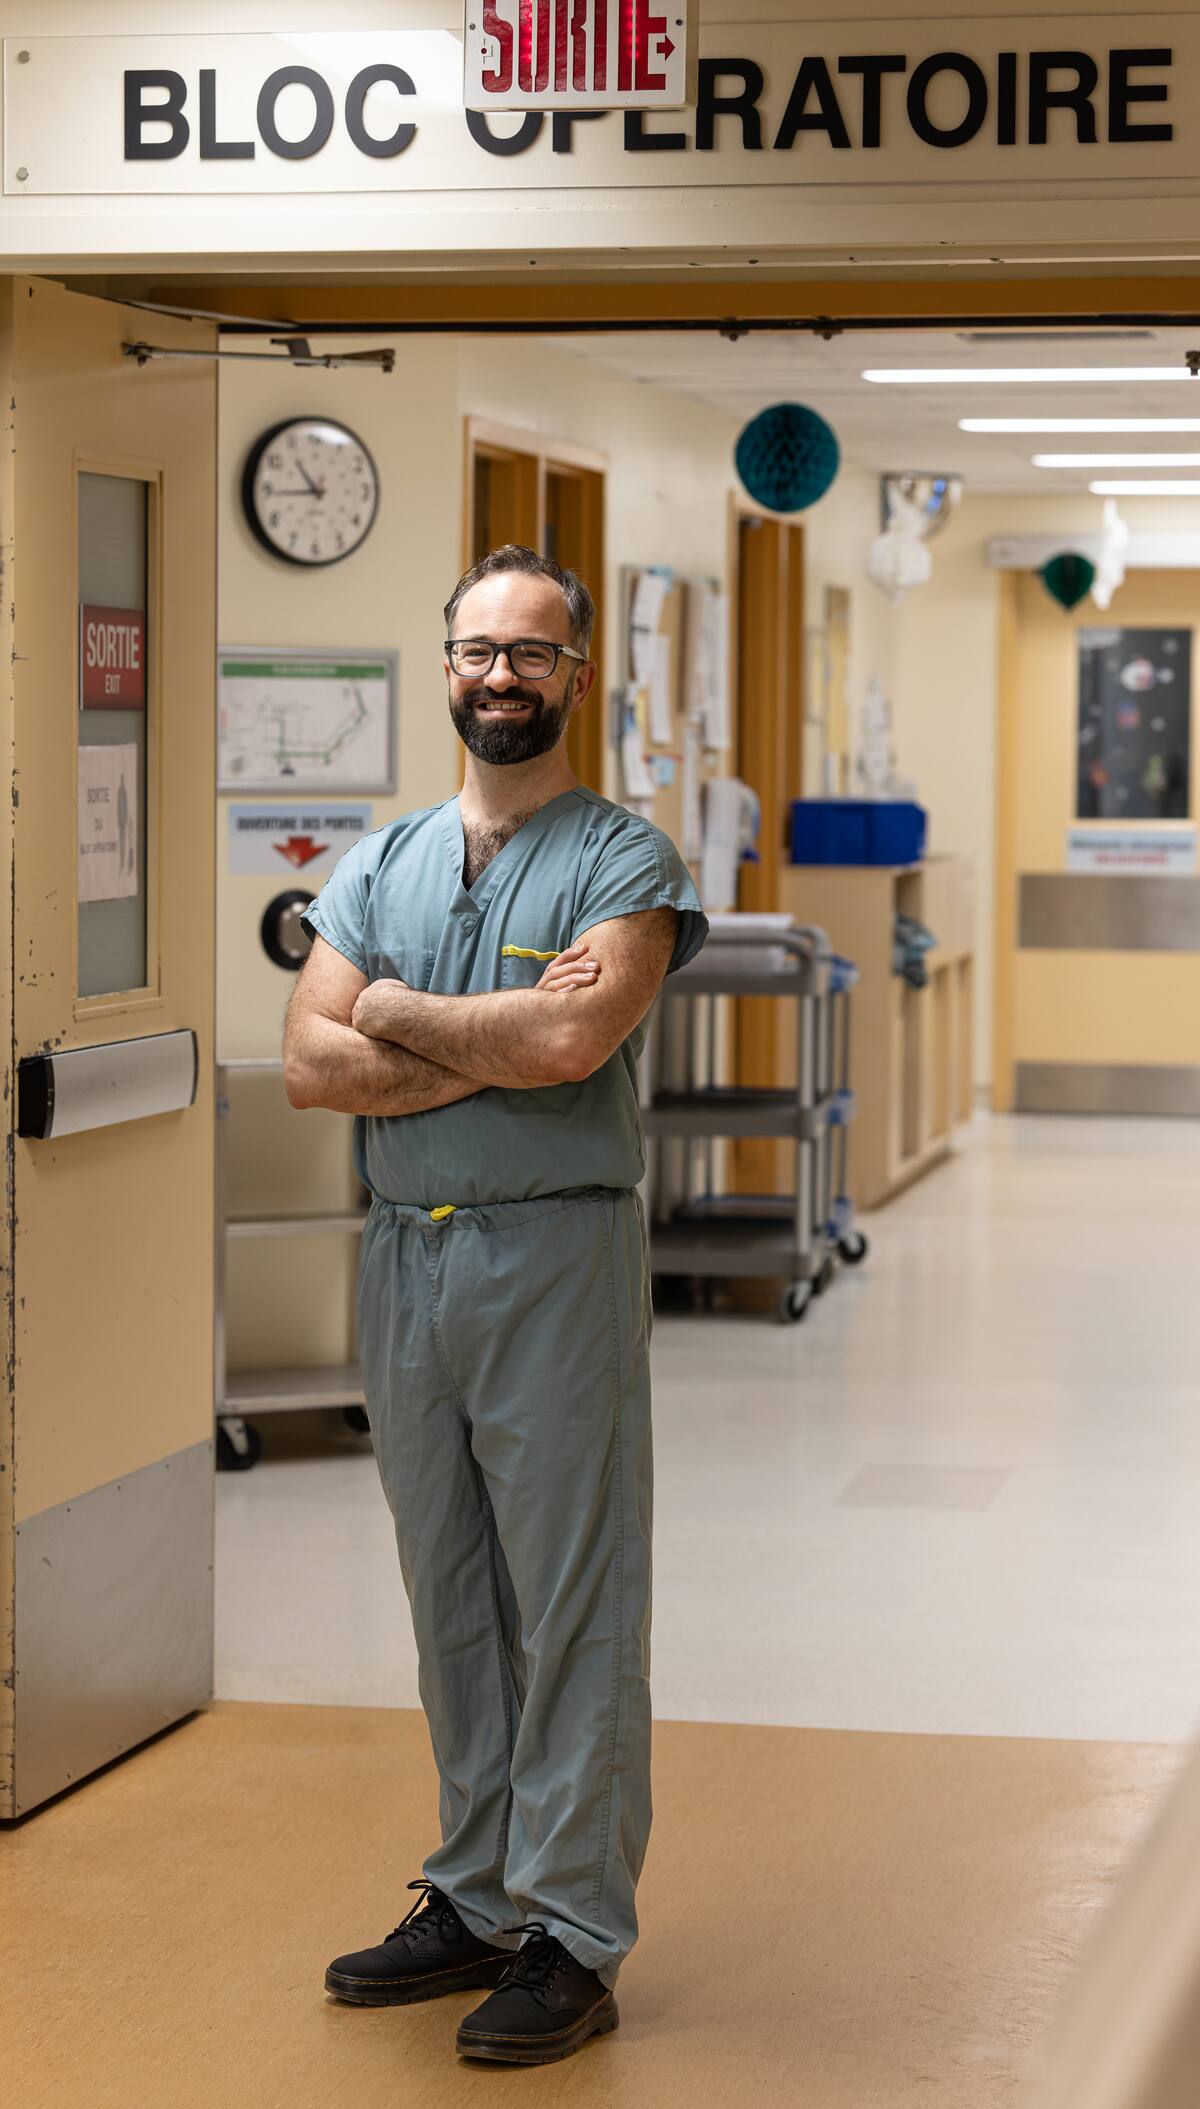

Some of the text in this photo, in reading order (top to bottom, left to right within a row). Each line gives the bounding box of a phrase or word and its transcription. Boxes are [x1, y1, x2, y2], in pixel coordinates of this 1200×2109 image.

[124, 63, 419, 160] BLOC
[86, 622, 140, 670] SORTIE
[105, 673, 121, 694] EXIT
[237, 816, 364, 831] OUVERTURE DES PORTES
